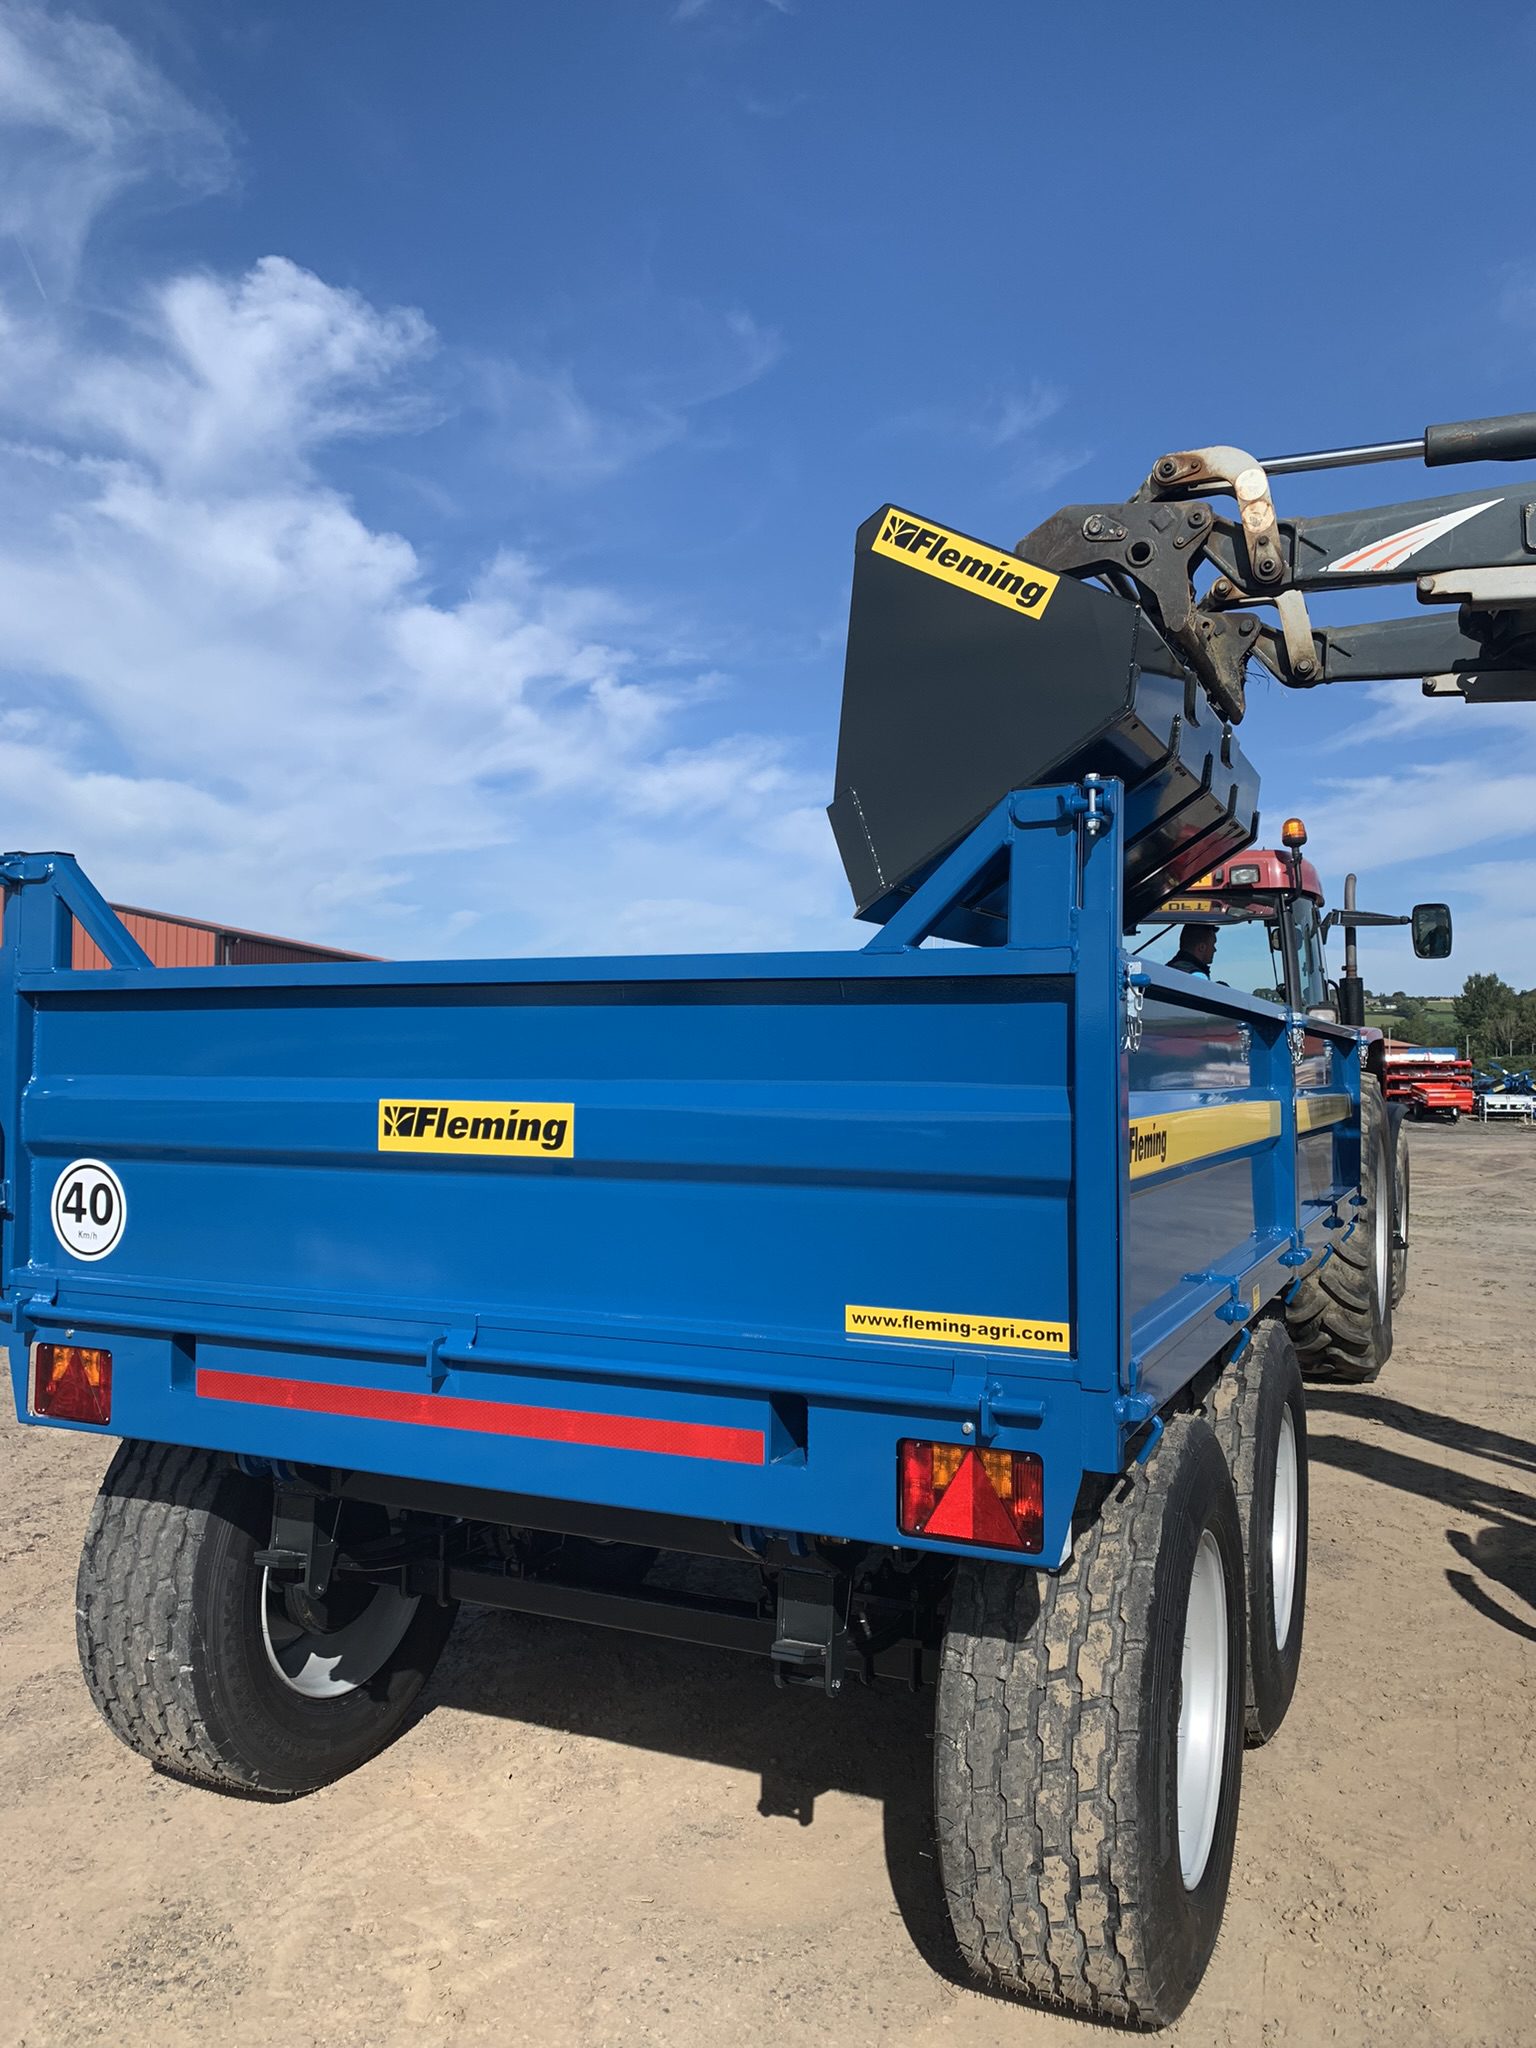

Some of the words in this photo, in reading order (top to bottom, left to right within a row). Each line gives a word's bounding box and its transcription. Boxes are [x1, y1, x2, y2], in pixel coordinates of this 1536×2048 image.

[905, 527, 1048, 609] Fleming
[413, 1106, 568, 1151] Fleming
[1129, 1122, 1167, 1163] Fleming
[62, 1181, 113, 1226] 40
[851, 1313, 1063, 1343] www.fleming-agri.com
